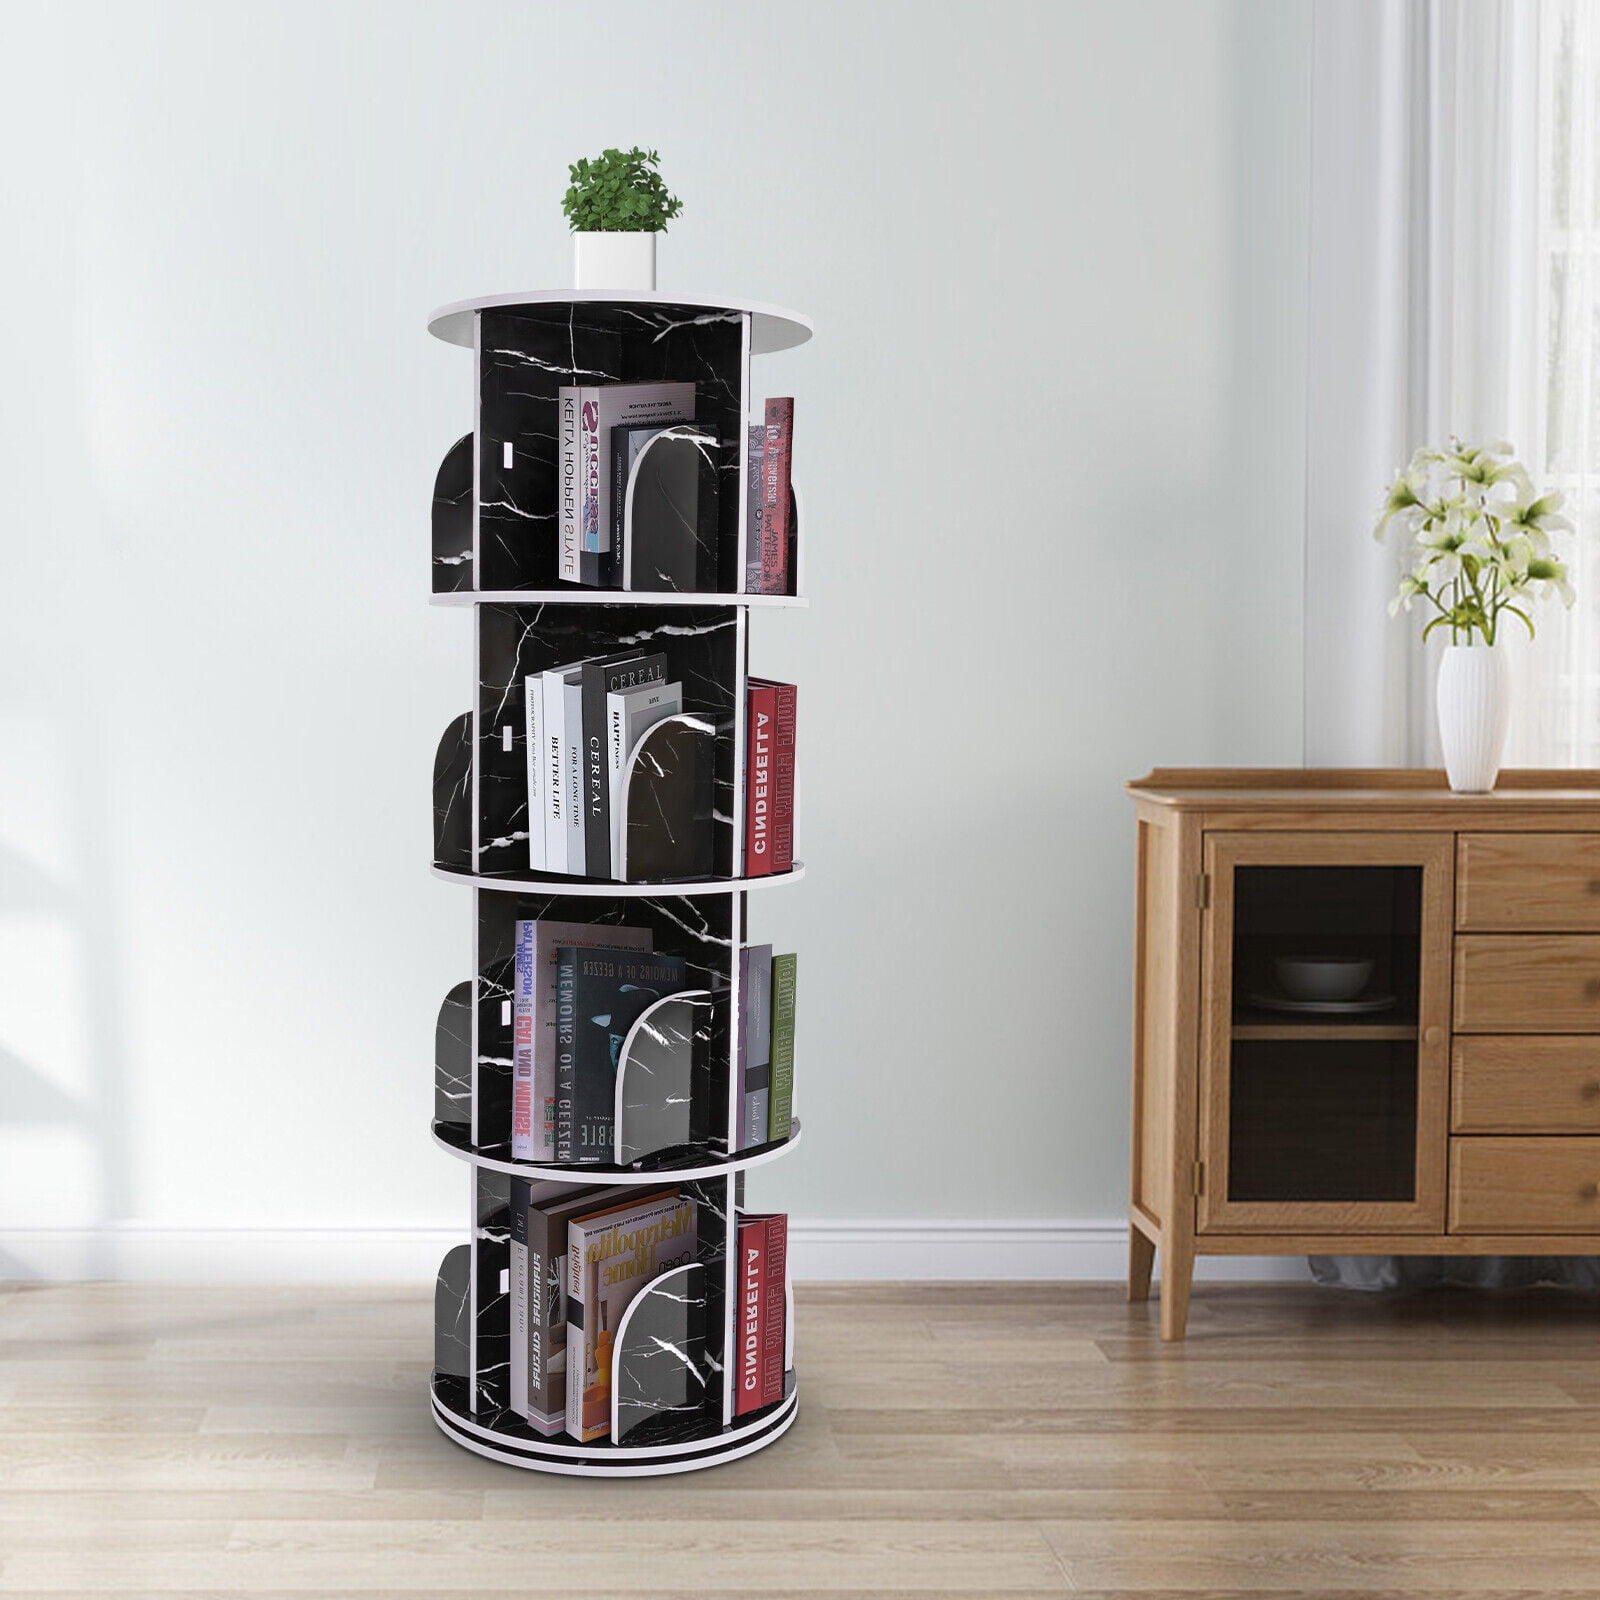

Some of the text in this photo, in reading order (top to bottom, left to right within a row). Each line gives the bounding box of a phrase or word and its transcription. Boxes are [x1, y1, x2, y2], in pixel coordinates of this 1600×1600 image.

[764, 514, 772, 582] PATTERSON
[770, 529, 778, 568] JAMES
[611, 665, 662, 691] CEREAL
[551, 736, 561, 819] BETTER LIFE
[590, 736, 601, 817] CEREAL
